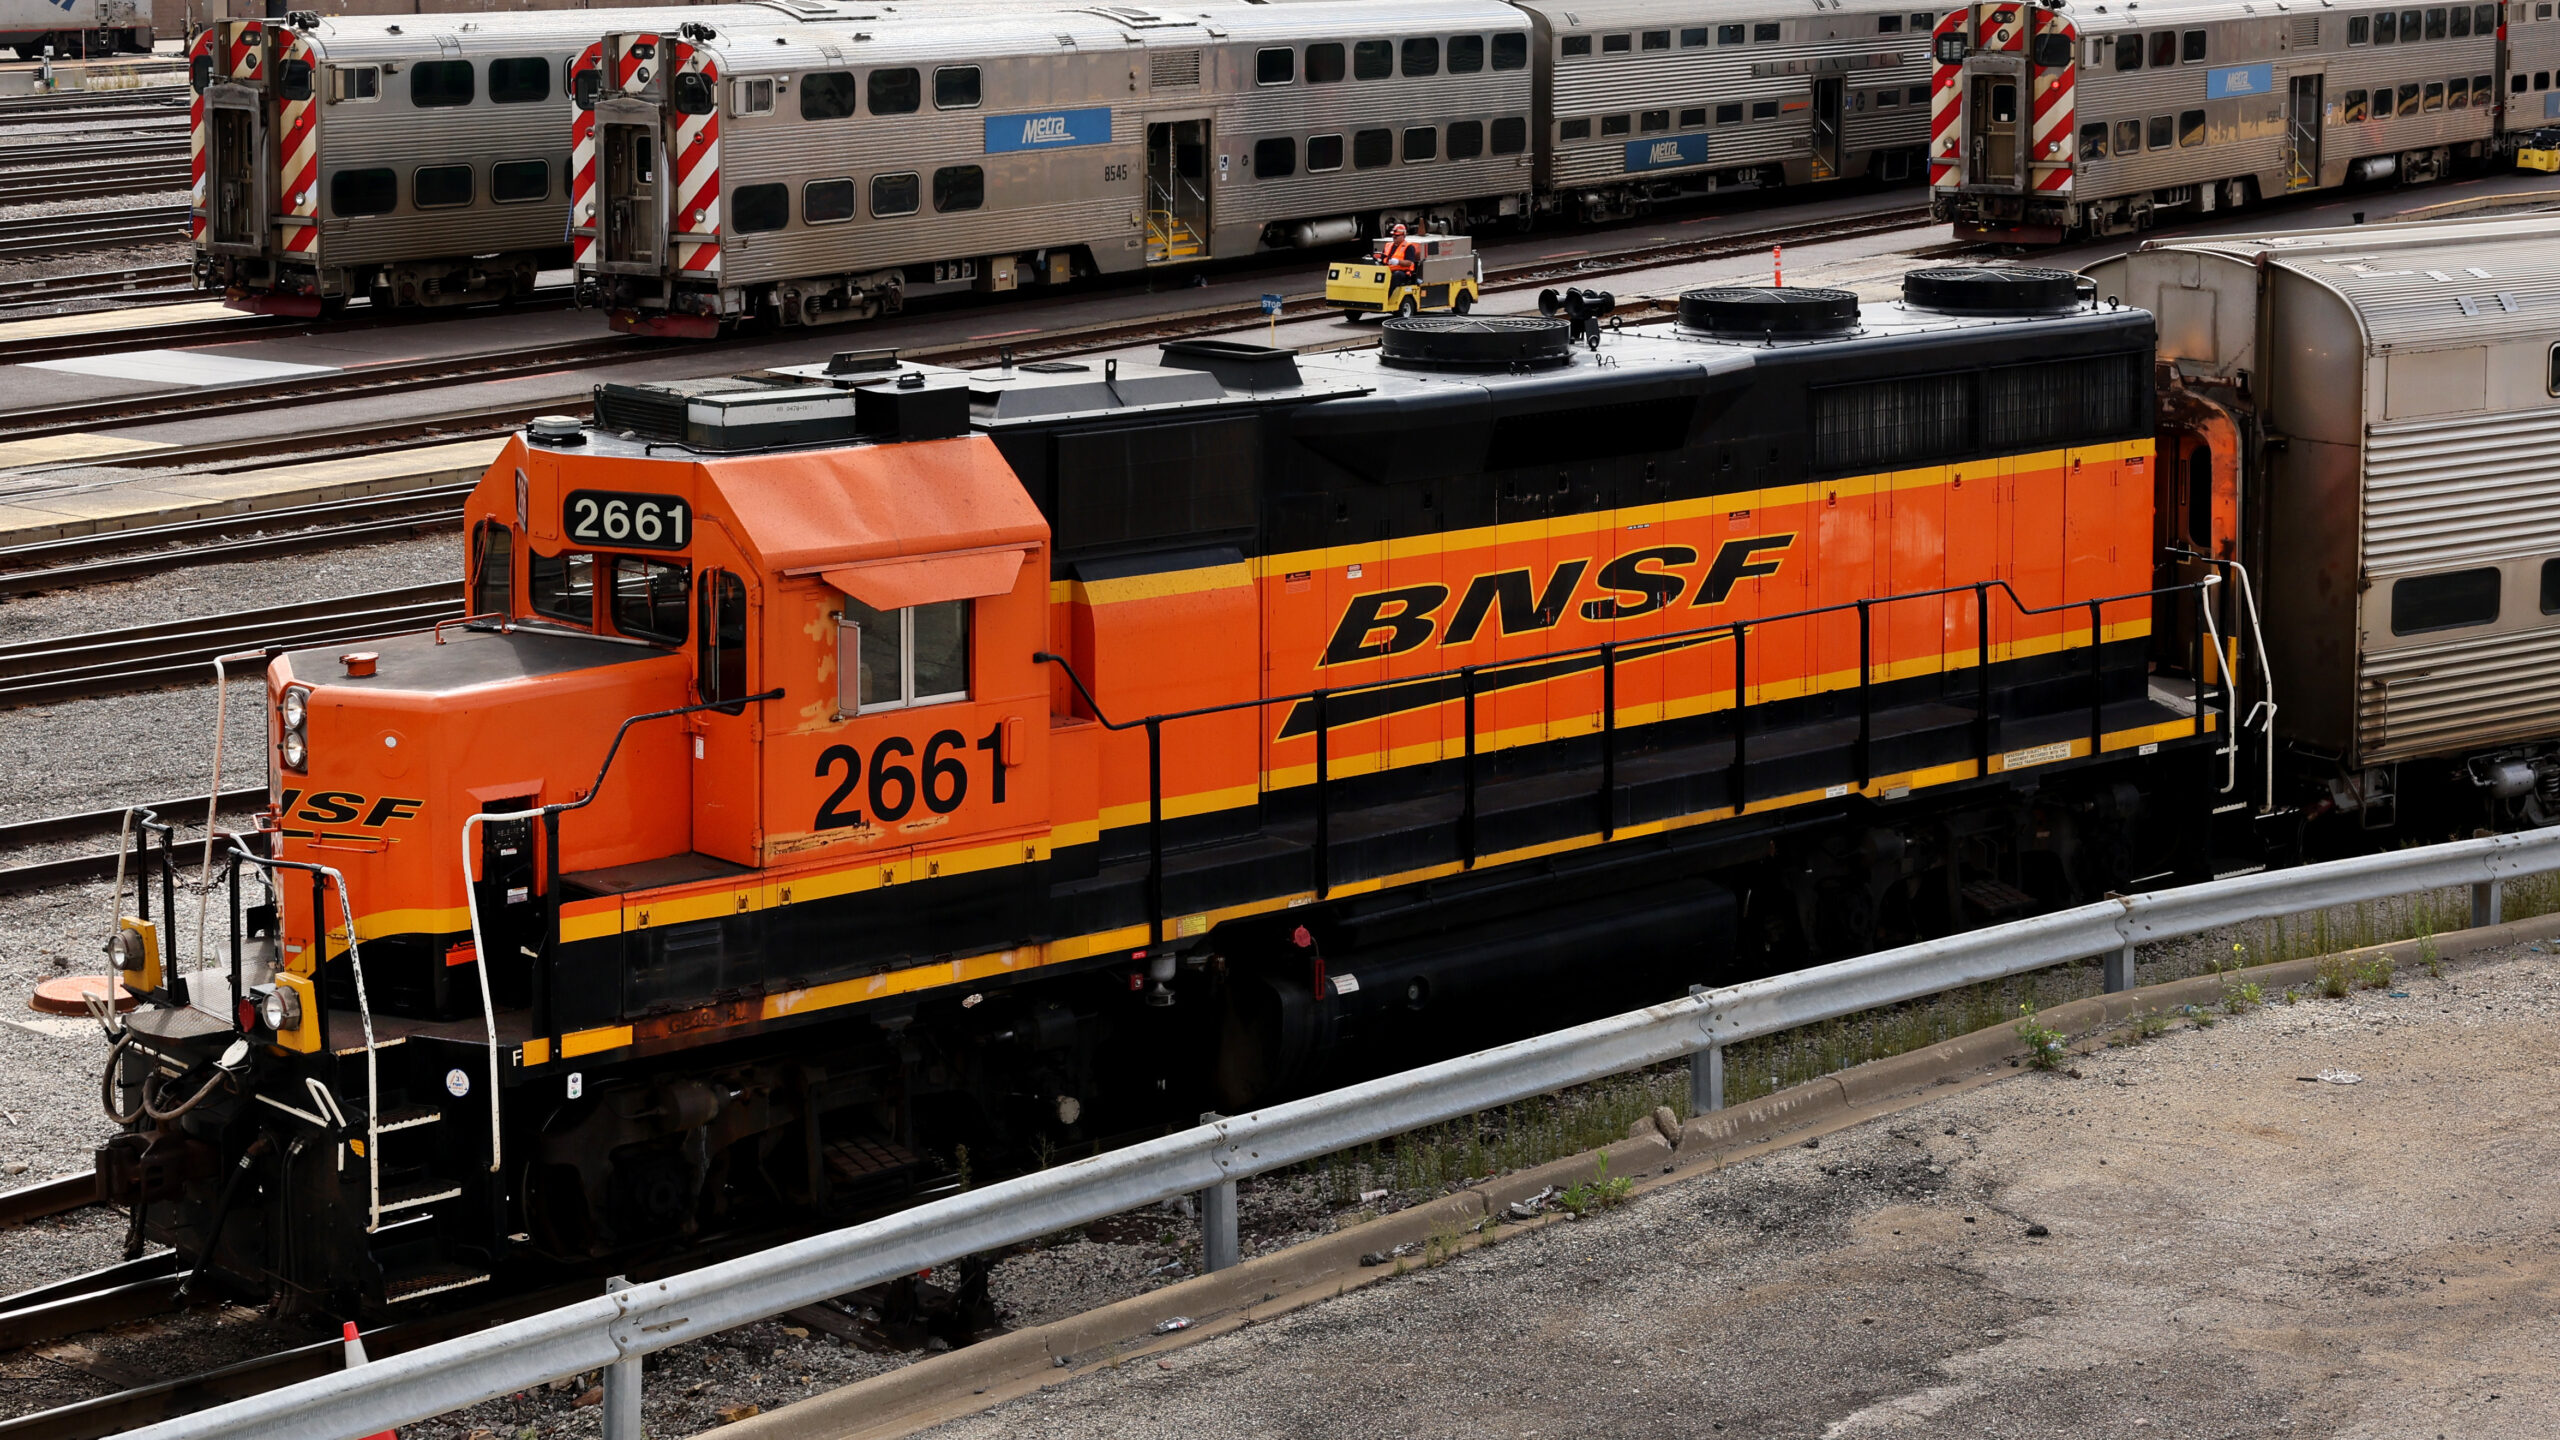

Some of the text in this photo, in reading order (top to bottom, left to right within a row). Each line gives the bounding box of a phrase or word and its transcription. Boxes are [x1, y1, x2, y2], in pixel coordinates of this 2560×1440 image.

[2225, 71, 2250, 92] Metra
[1022, 117, 1066, 144] Metra
[1649, 141, 1679, 164] Metra
[1104, 164, 1128, 182] 8545
[1262, 300, 1282, 309] STOP
[574, 498, 683, 544] 2661
[1312, 530, 1800, 671] BNSF
[814, 722, 1006, 831] 2661
[512, 1049, 523, 1067] F
